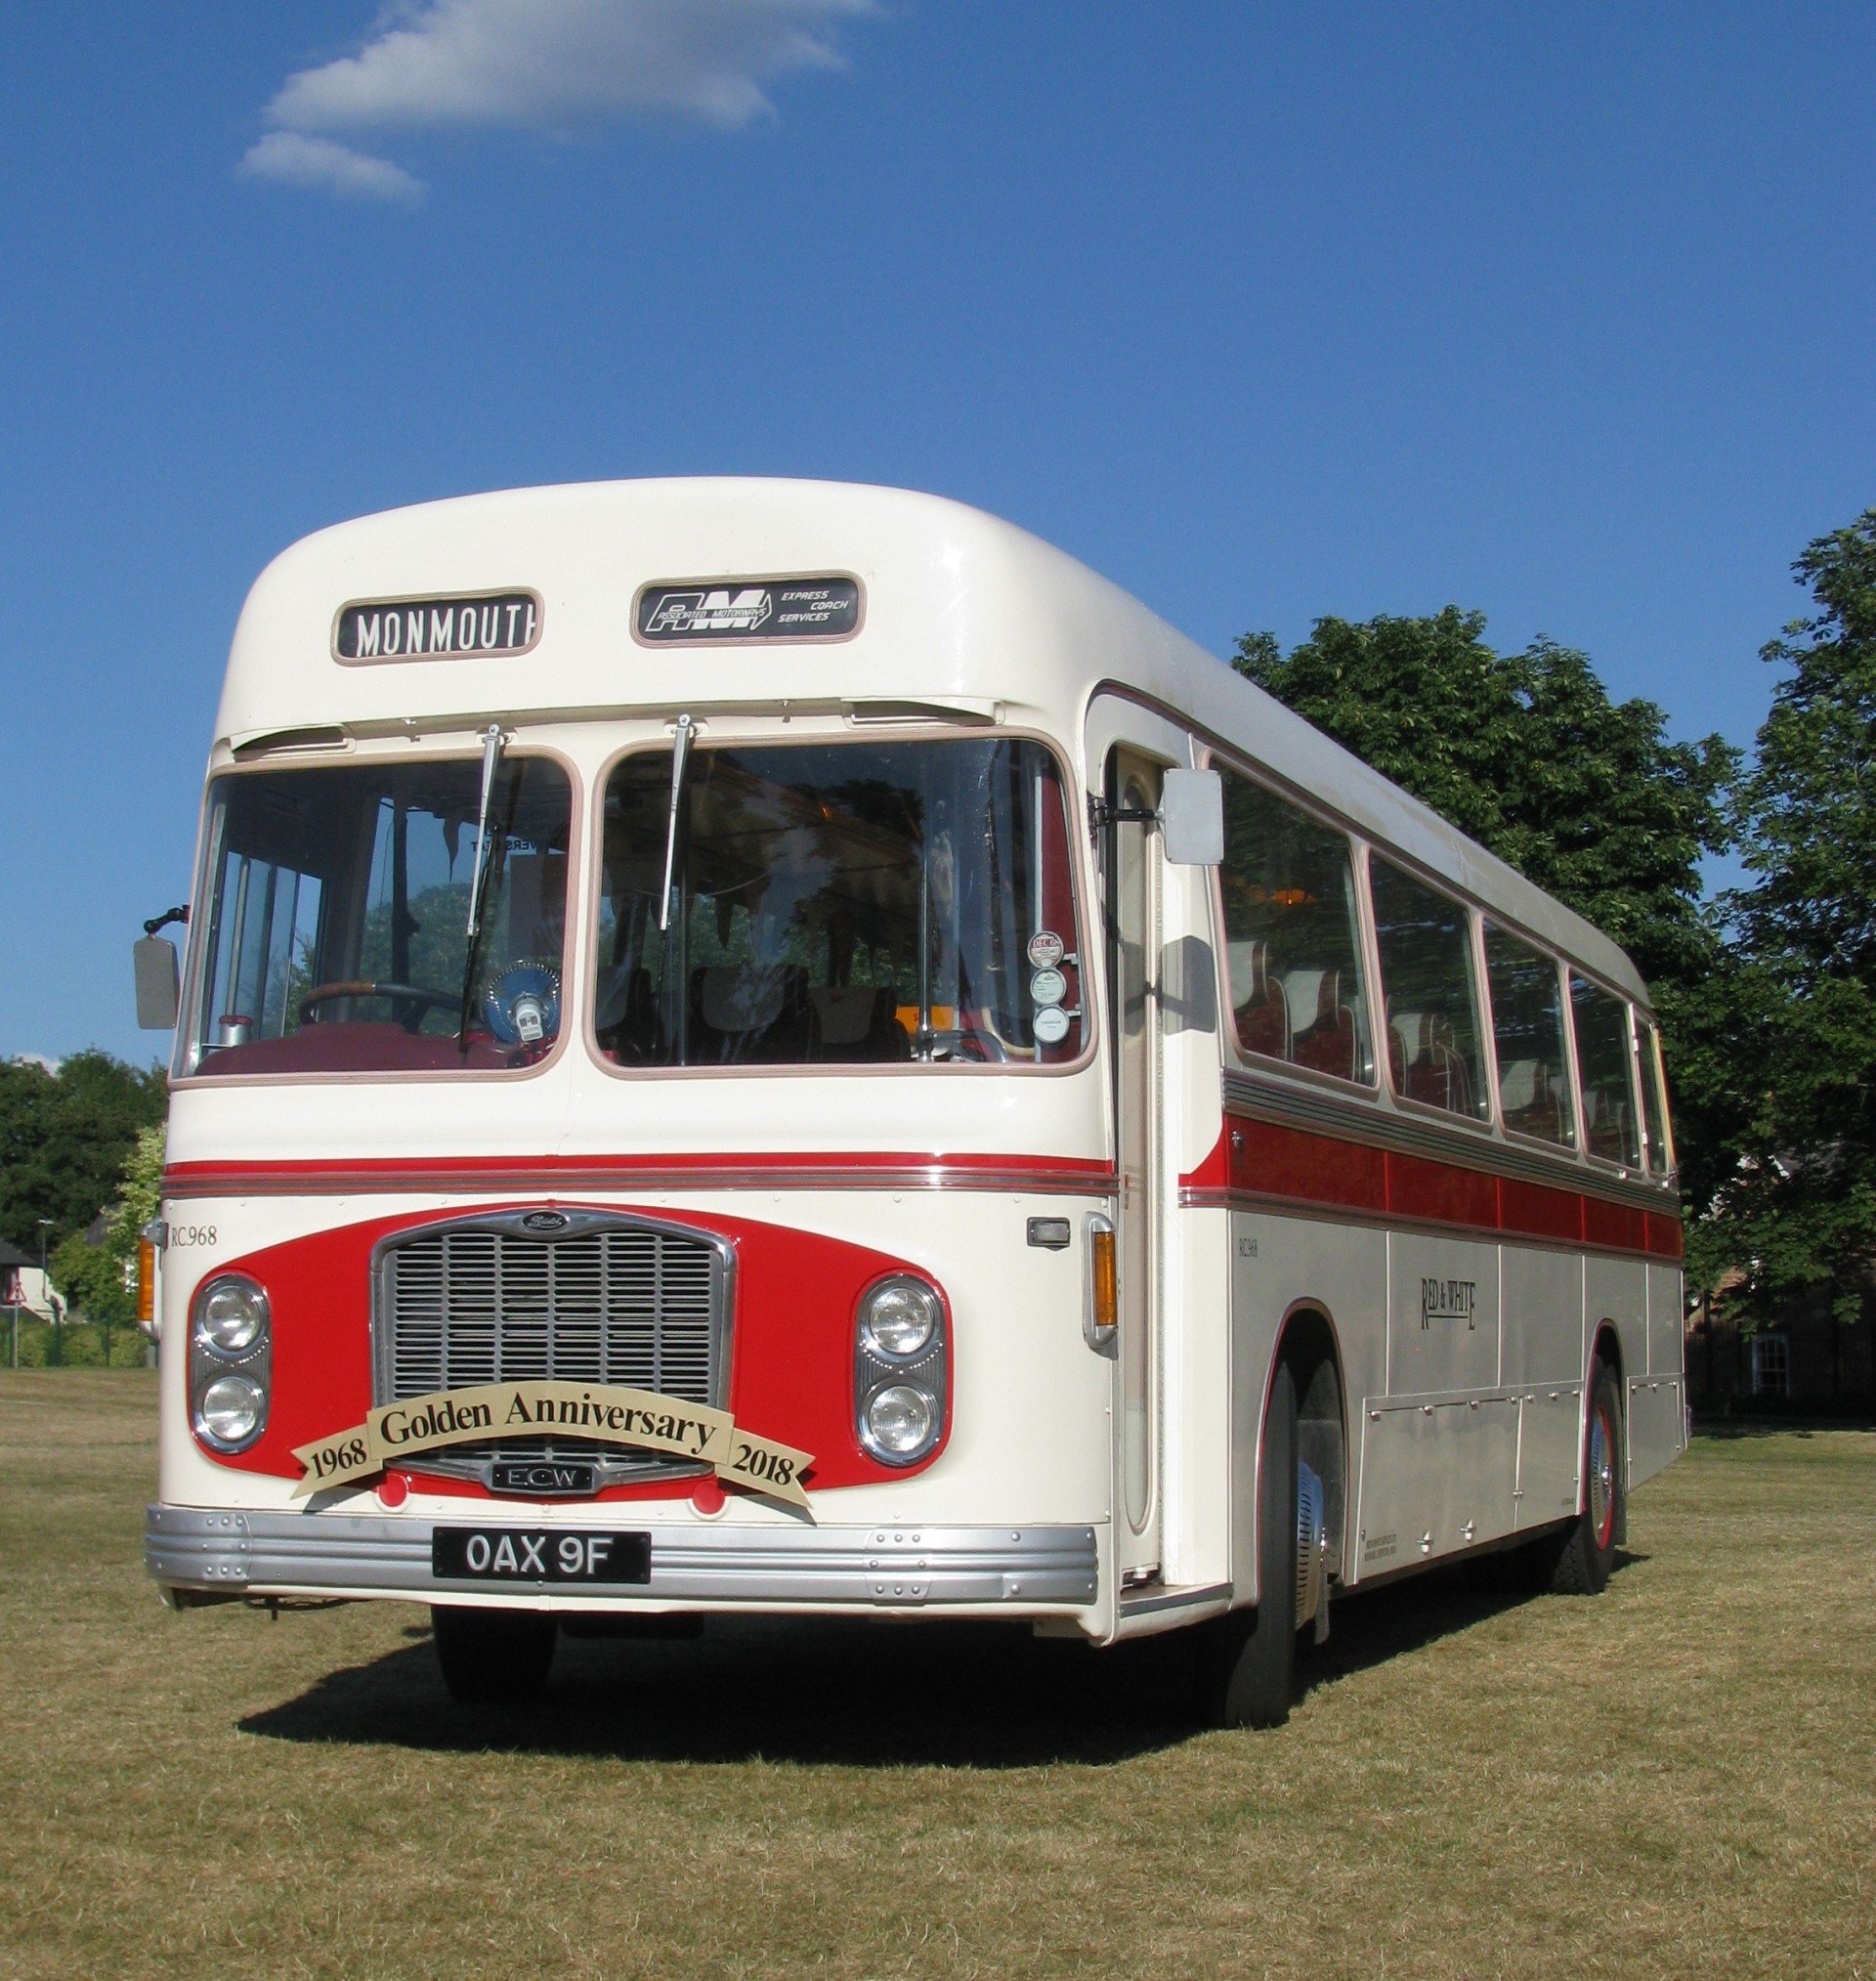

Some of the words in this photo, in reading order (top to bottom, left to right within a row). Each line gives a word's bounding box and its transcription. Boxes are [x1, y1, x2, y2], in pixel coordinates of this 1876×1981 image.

[781, 590, 830, 601] EXPRESS
[810, 600, 849, 610] COACH
[657, 610, 707, 621] ASSOCIATED
[711, 607, 767, 619] MOTORWAYS
[778, 612, 831, 623] SERVICES
[1422, 1278, 1438, 1330] RED
[1440, 1282, 1445, 1310] &
[1447, 1280, 1475, 1330] WHITE
[311, 1438, 367, 1479] 1968
[380, 1400, 493, 1444] Golden
[505, 1392, 718, 1455] Anniversary
[731, 1443, 794, 1486] 2018
[466, 1534, 546, 1573] OAX
[558, 1535, 614, 1575] 9F
